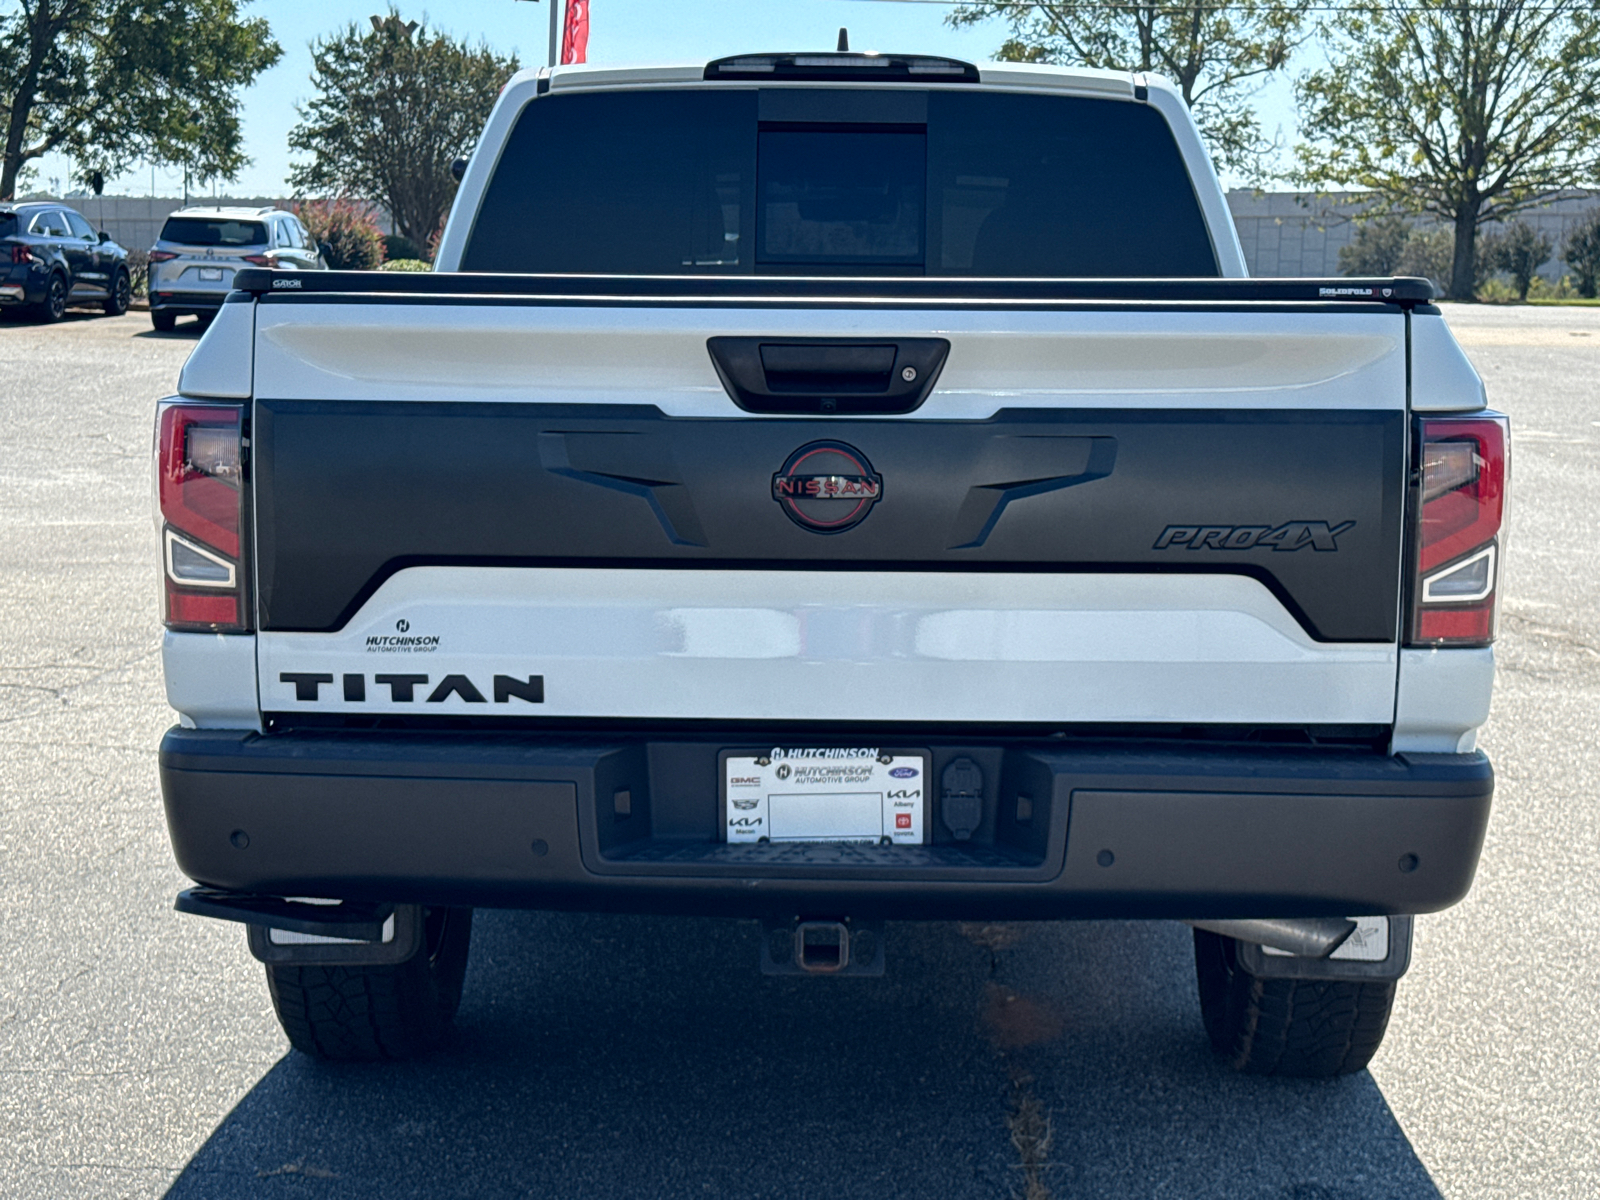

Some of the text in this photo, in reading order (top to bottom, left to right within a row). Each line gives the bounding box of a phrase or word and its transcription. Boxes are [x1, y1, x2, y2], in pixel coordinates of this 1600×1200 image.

[272, 280, 302, 288] GATOR
[778, 480, 876, 494] NISSAN
[1152, 520, 1357, 552] PRO4X
[365, 635, 440, 646] HUTCHINSON
[279, 672, 544, 704] TITAN
[787, 747, 880, 759] HUTCHINSON
[794, 765, 873, 776] HUTCHINSON
[795, 775, 870, 784] AUTOMOTIVE GROUP
[887, 790, 920, 799] KIA
[729, 817, 763, 827] KIA
